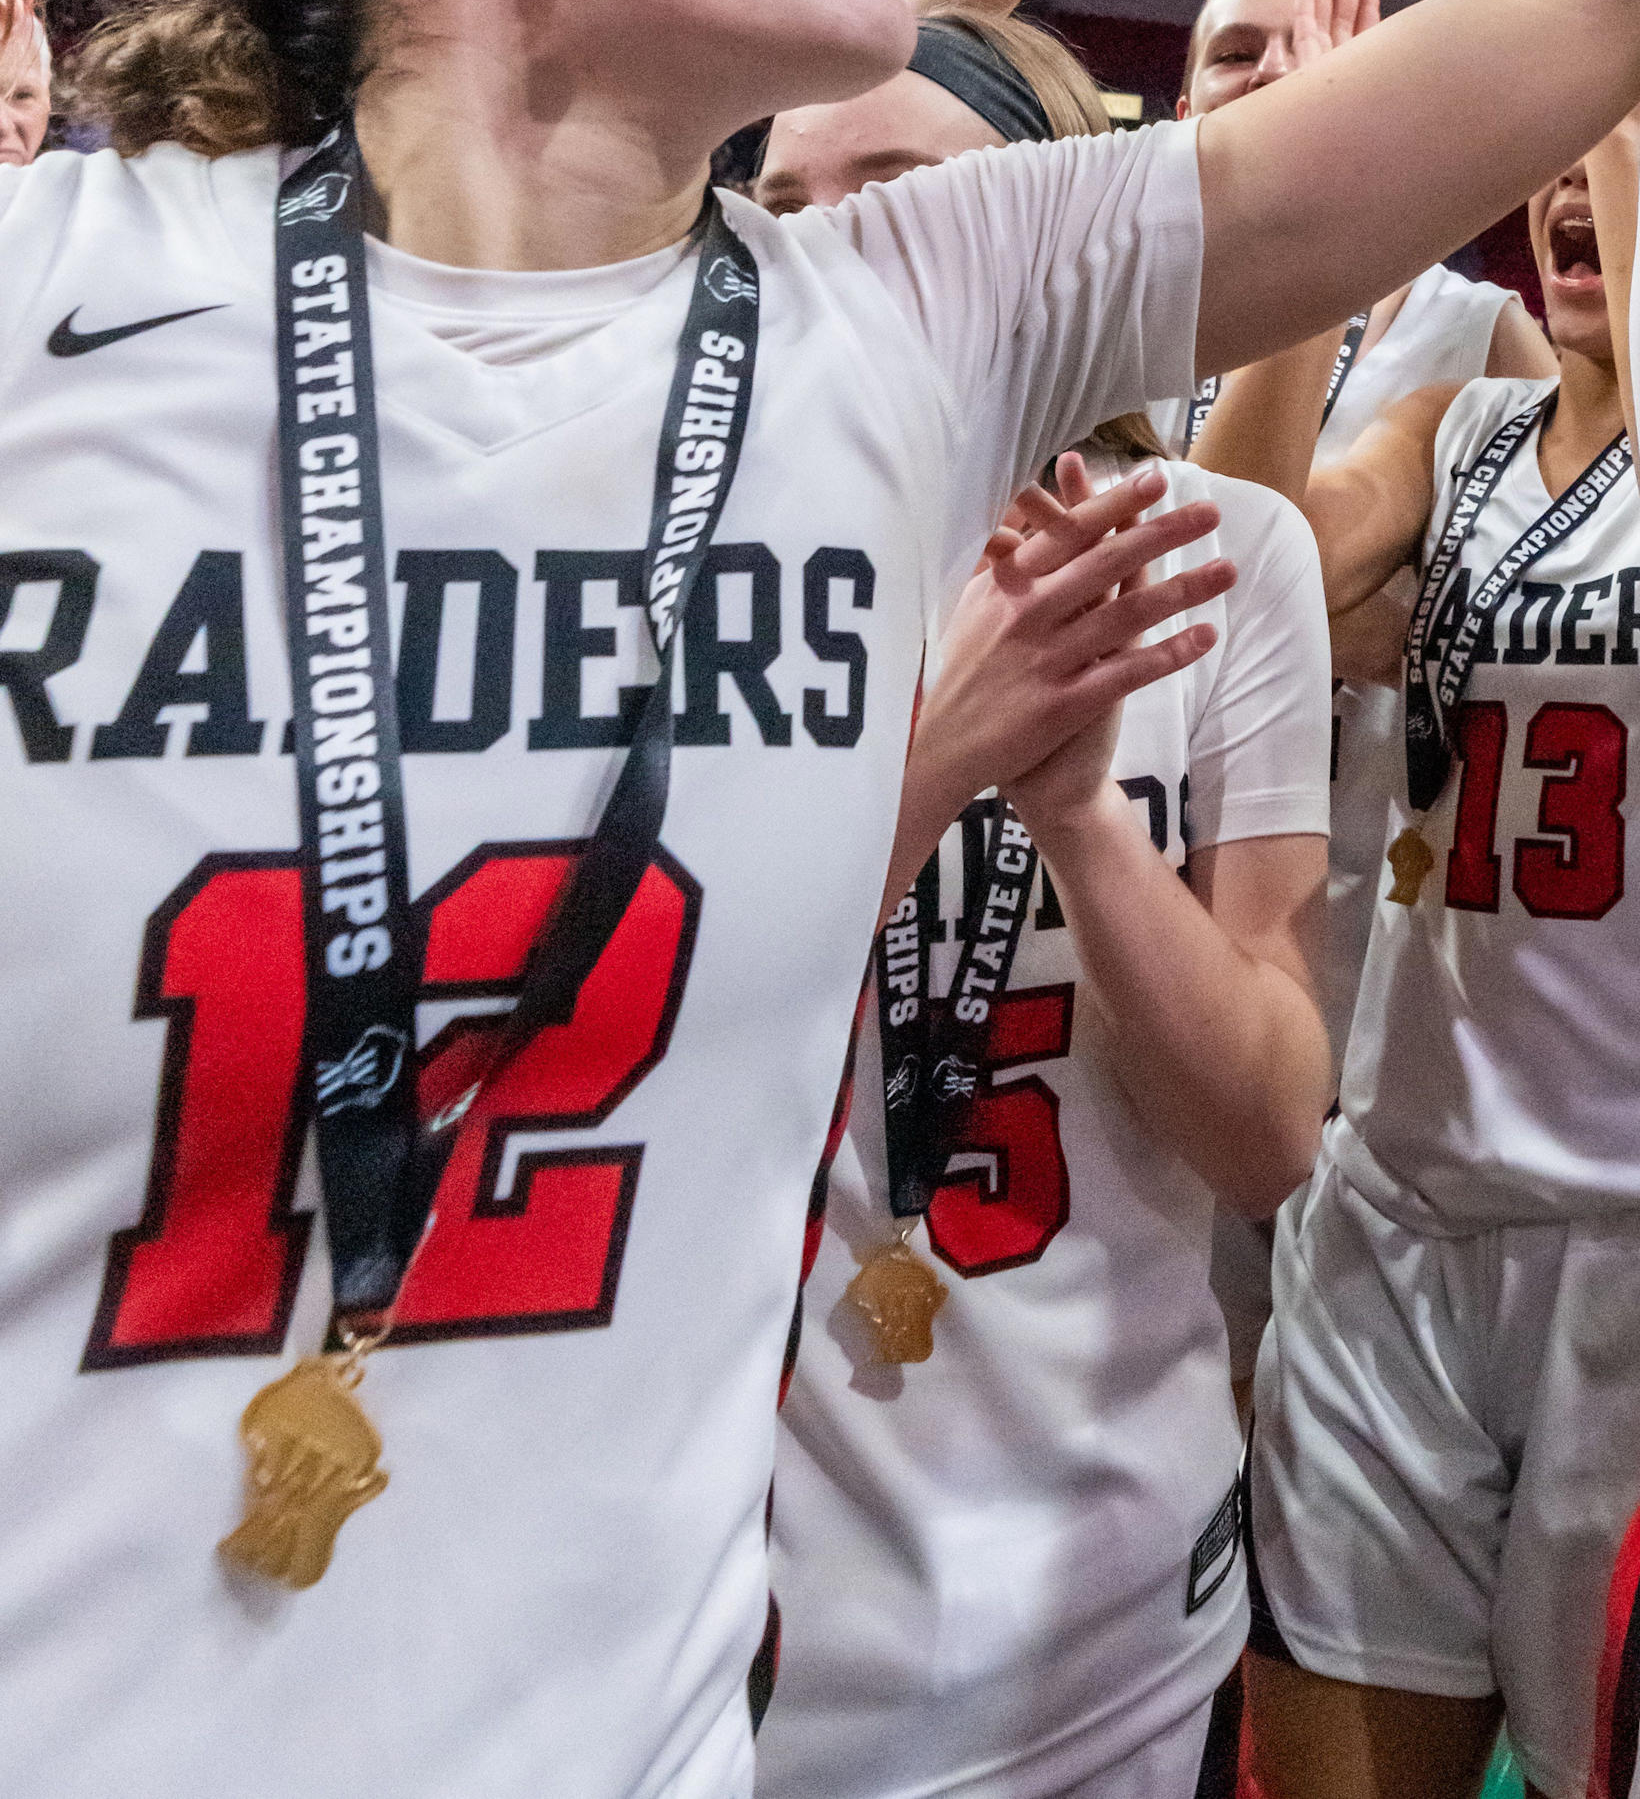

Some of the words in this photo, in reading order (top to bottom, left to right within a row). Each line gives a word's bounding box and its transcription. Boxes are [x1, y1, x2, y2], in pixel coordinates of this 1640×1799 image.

[291, 254, 357, 424] STATE
[0, 543, 877, 764] RADERS
[1409, 465, 1497, 685] CHAMPIONSHIPS
[1439, 612, 1483, 706] STATE
[1474, 435, 1633, 611] CHAMPIONSHIPS
[299, 431, 394, 979] CHAMPIONSHIPS
[1444, 699, 1628, 921] 13
[955, 884, 1021, 1025] STATE
[78, 834, 705, 1374] 12
